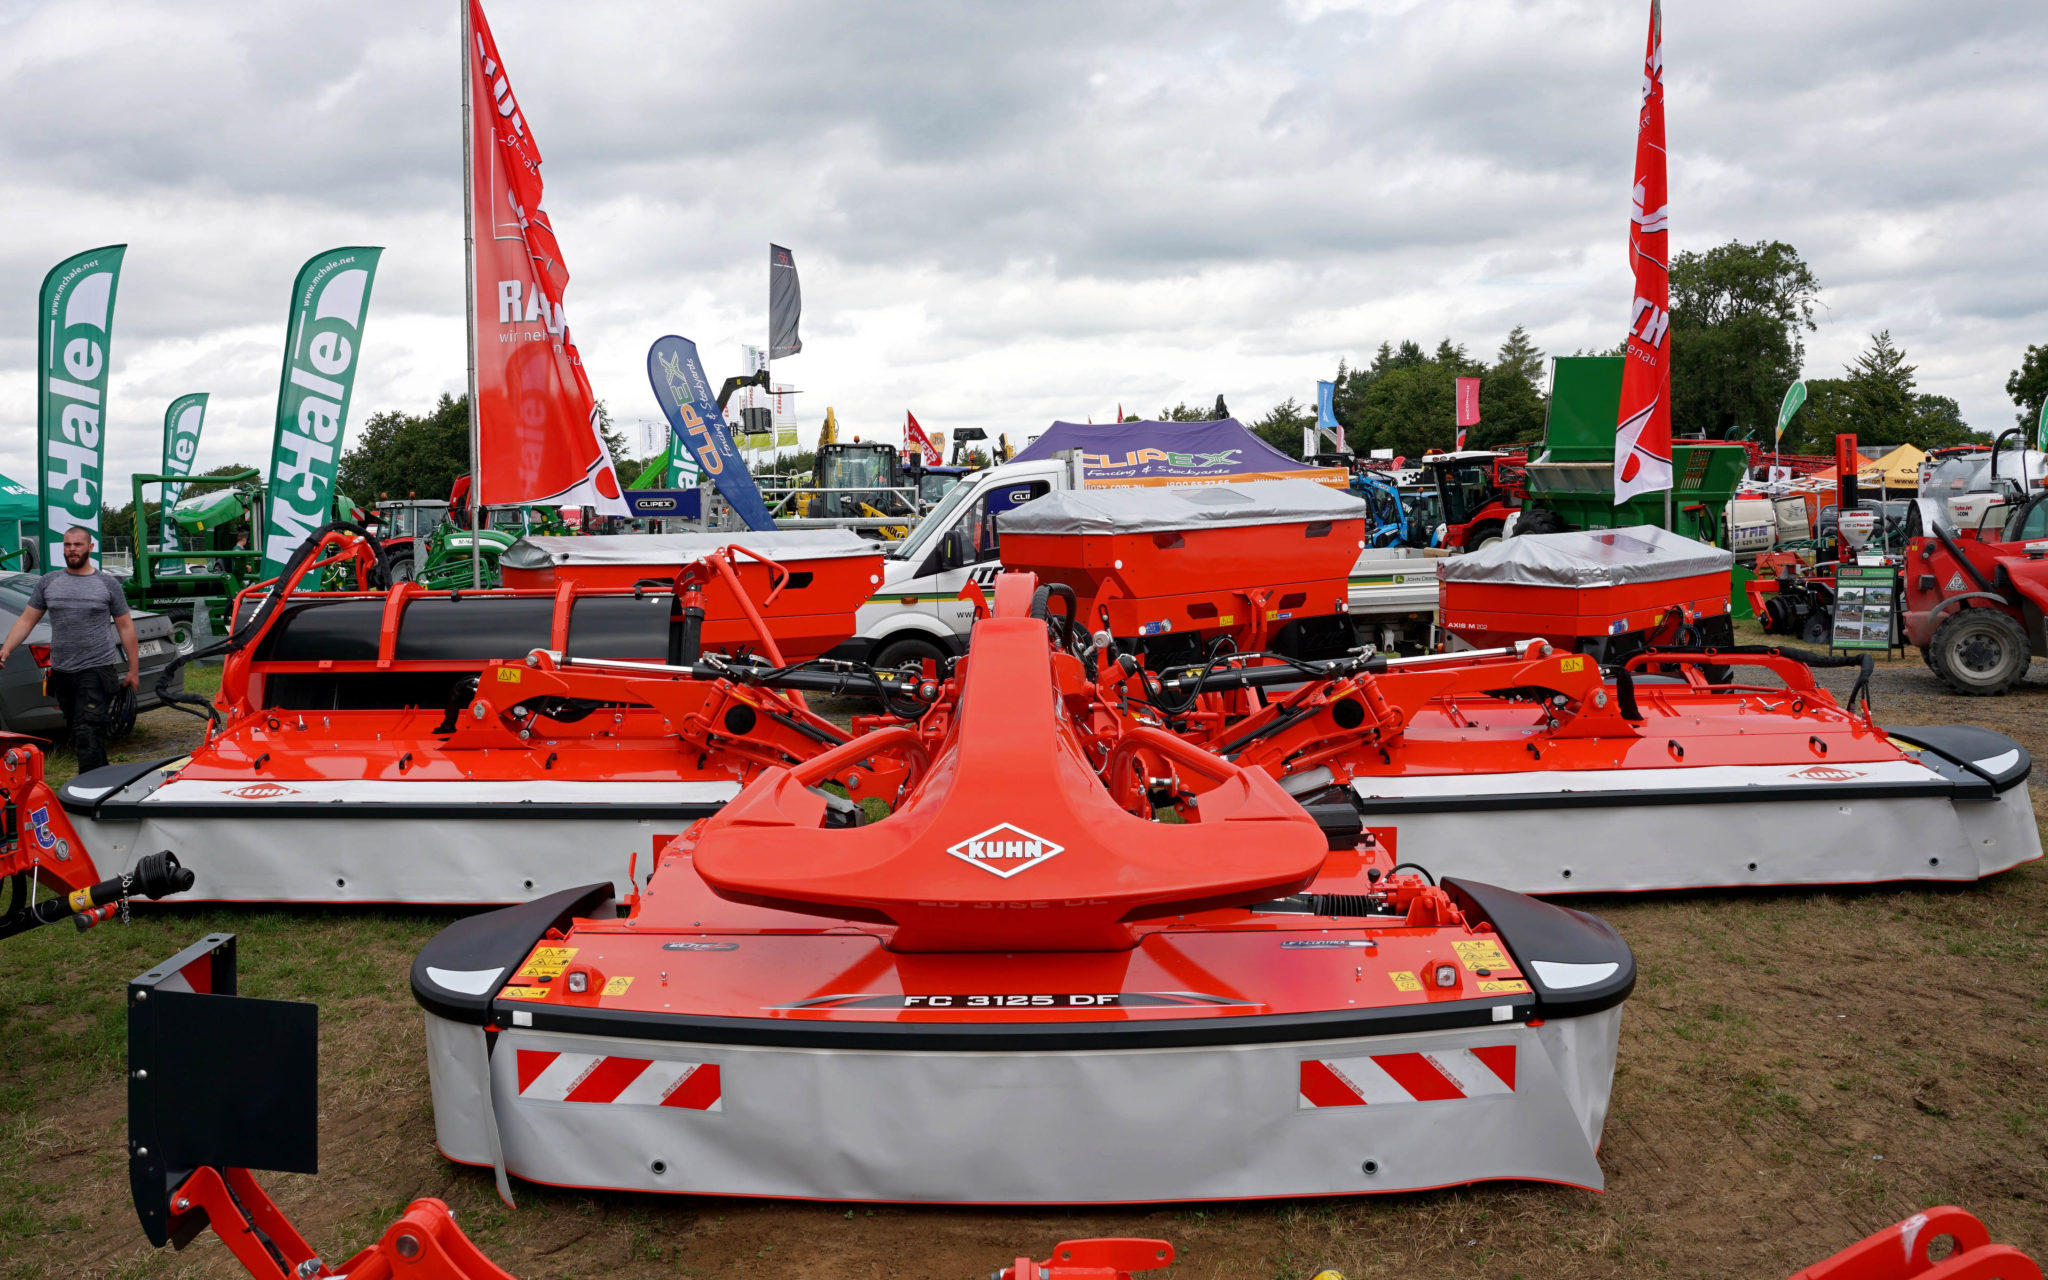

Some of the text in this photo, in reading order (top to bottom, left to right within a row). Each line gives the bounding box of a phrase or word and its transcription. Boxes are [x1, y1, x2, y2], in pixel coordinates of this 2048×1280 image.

[51, 259, 99, 316] www.mchale.net
[304, 256, 355, 306] www.mchale.net
[687, 358, 712, 410] Stockyards
[659, 350, 724, 475] CLIPEX
[266, 331, 352, 574] McHale
[713, 423, 733, 458] Fencing
[1083, 448, 1243, 468] CLIPEX
[1087, 469, 1136, 477] Fencing
[1155, 465, 1231, 476] Stockyards
[162, 438, 195, 552] MHale
[229, 787, 292, 796] KUHN
[968, 840, 1042, 858] KUHN
[904, 994, 1119, 1006] FC 3125 DF
